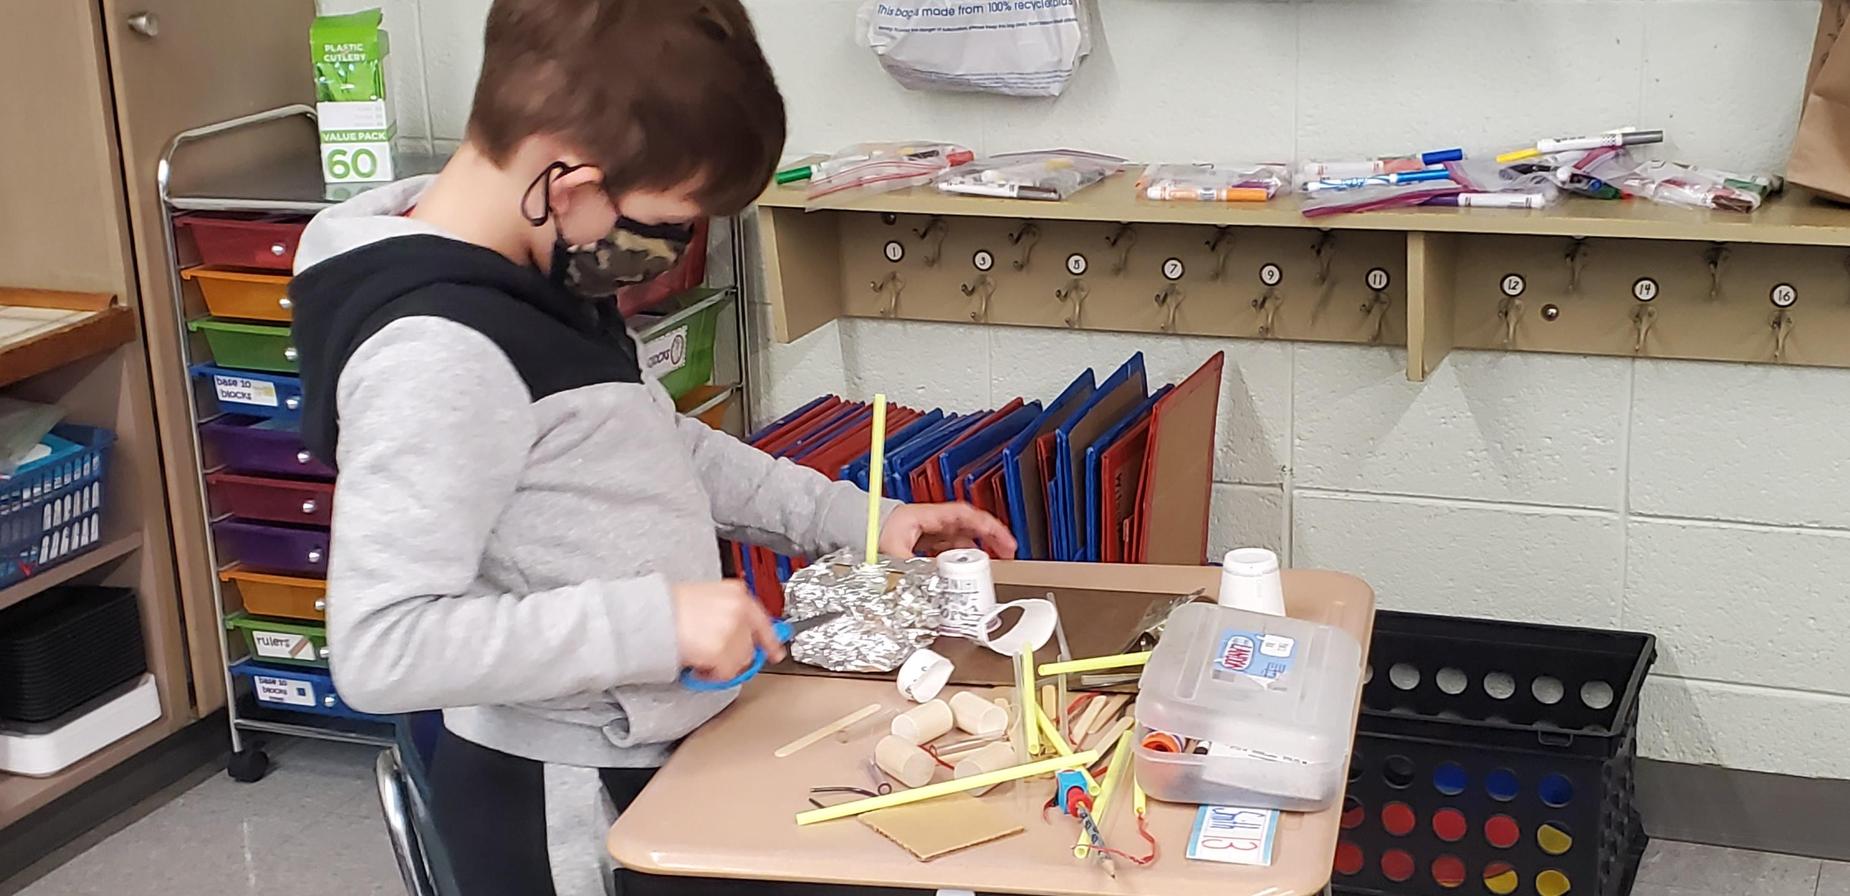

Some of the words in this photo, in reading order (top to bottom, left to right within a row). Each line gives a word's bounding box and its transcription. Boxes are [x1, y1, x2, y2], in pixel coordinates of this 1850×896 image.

[878, 4, 894, 16] This
[922, 7, 955, 17] made
[958, 5, 984, 16] from
[988, 1, 1011, 13] 100%
[324, 43, 364, 53] PLASTIC
[323, 53, 366, 63] CUTLERY
[323, 132, 357, 142] VALUE
[358, 131, 386, 141] PACK
[326, 148, 378, 180] 60
[979, 256, 988, 266] 3
[1073, 257, 1081, 271] 5
[1168, 263, 1179, 275] 7
[1266, 269, 1275, 281] 9
[1372, 274, 1384, 286] 11
[1507, 279, 1519, 291] 12
[1639, 284, 1652, 296] 14
[1778, 290, 1792, 303] 16
[216, 378, 238, 388] base
[240, 380, 252, 389] 10
[221, 390, 252, 400] blocks
[256, 636, 291, 648] rulers
